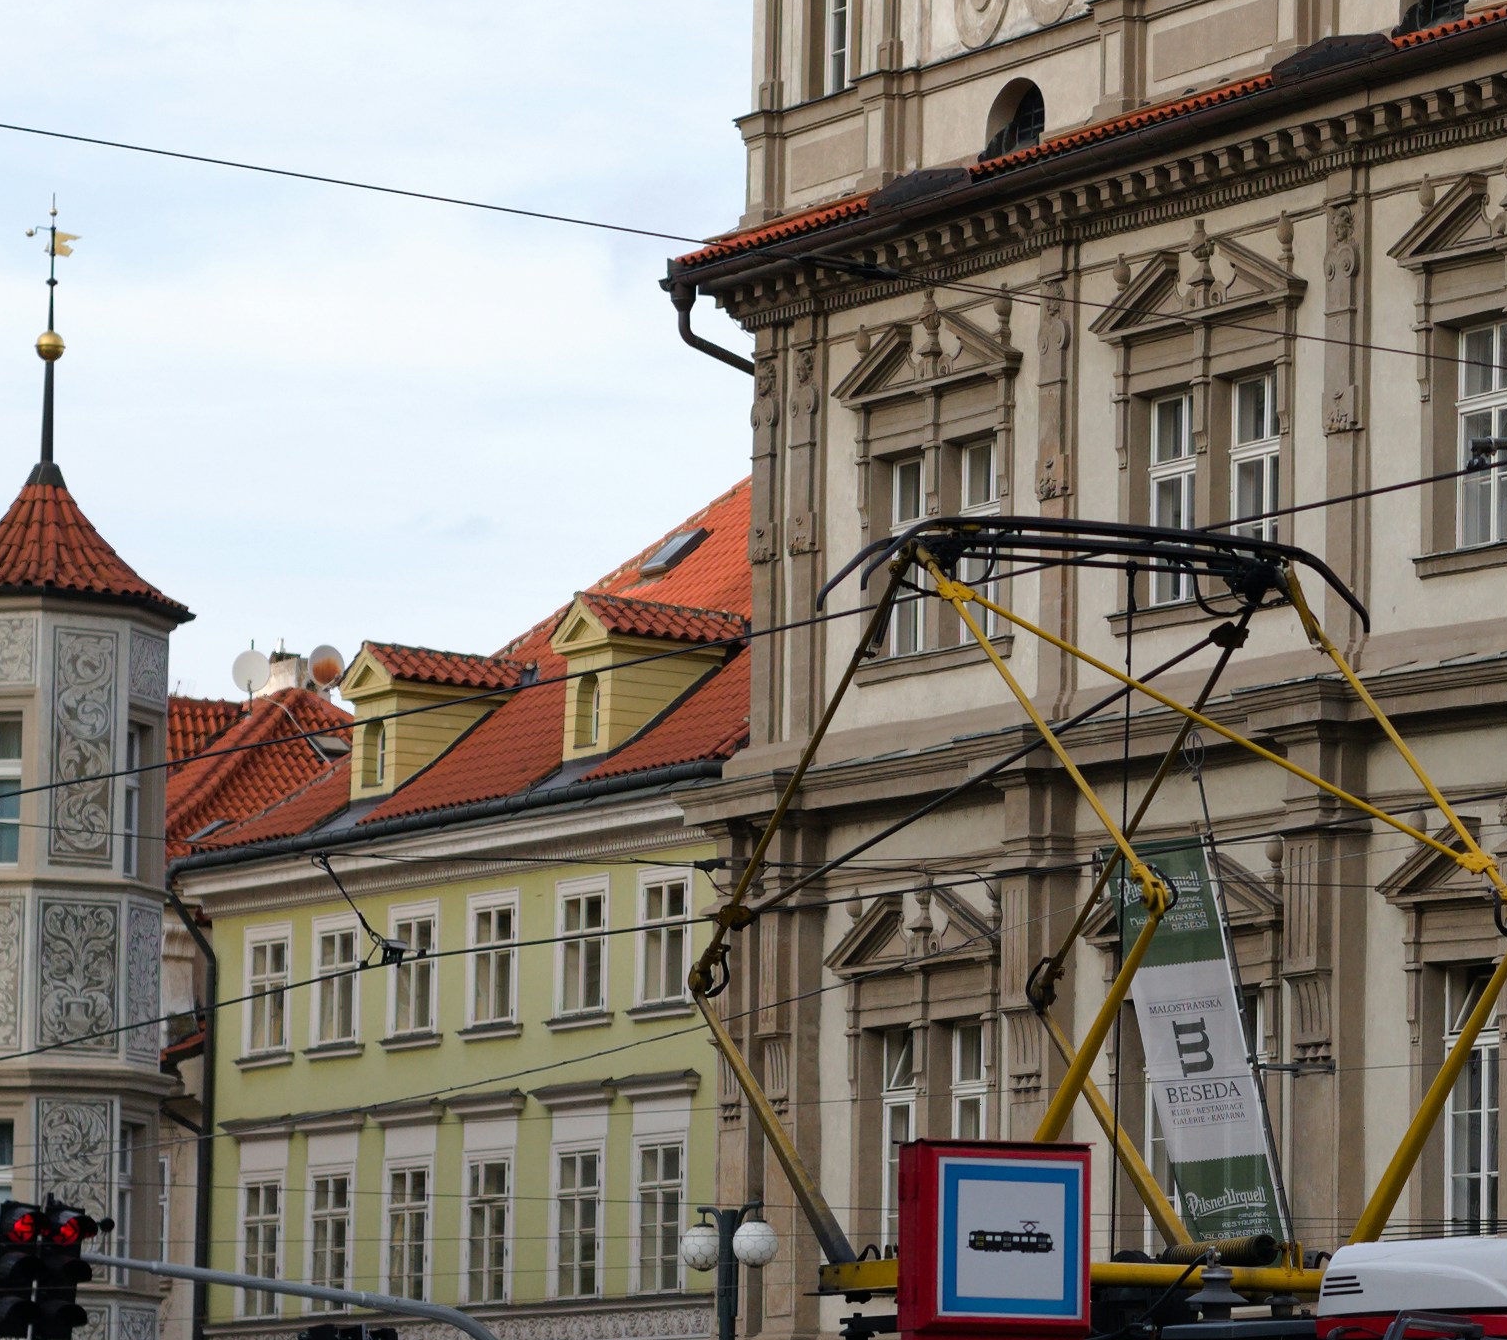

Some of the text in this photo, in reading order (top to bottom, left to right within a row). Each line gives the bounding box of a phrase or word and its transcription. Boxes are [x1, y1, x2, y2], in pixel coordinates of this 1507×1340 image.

[1149, 997, 1223, 1015] MALOSTRANSKÁ
[1166, 1081, 1241, 1104] BESEDA
[1171, 1102, 1244, 1117] KLUB RESTAURACE
[1173, 1110, 1246, 1126] GALERIE KAVÁRNA
[1185, 1186, 1267, 1220] Pilsner Urquell
